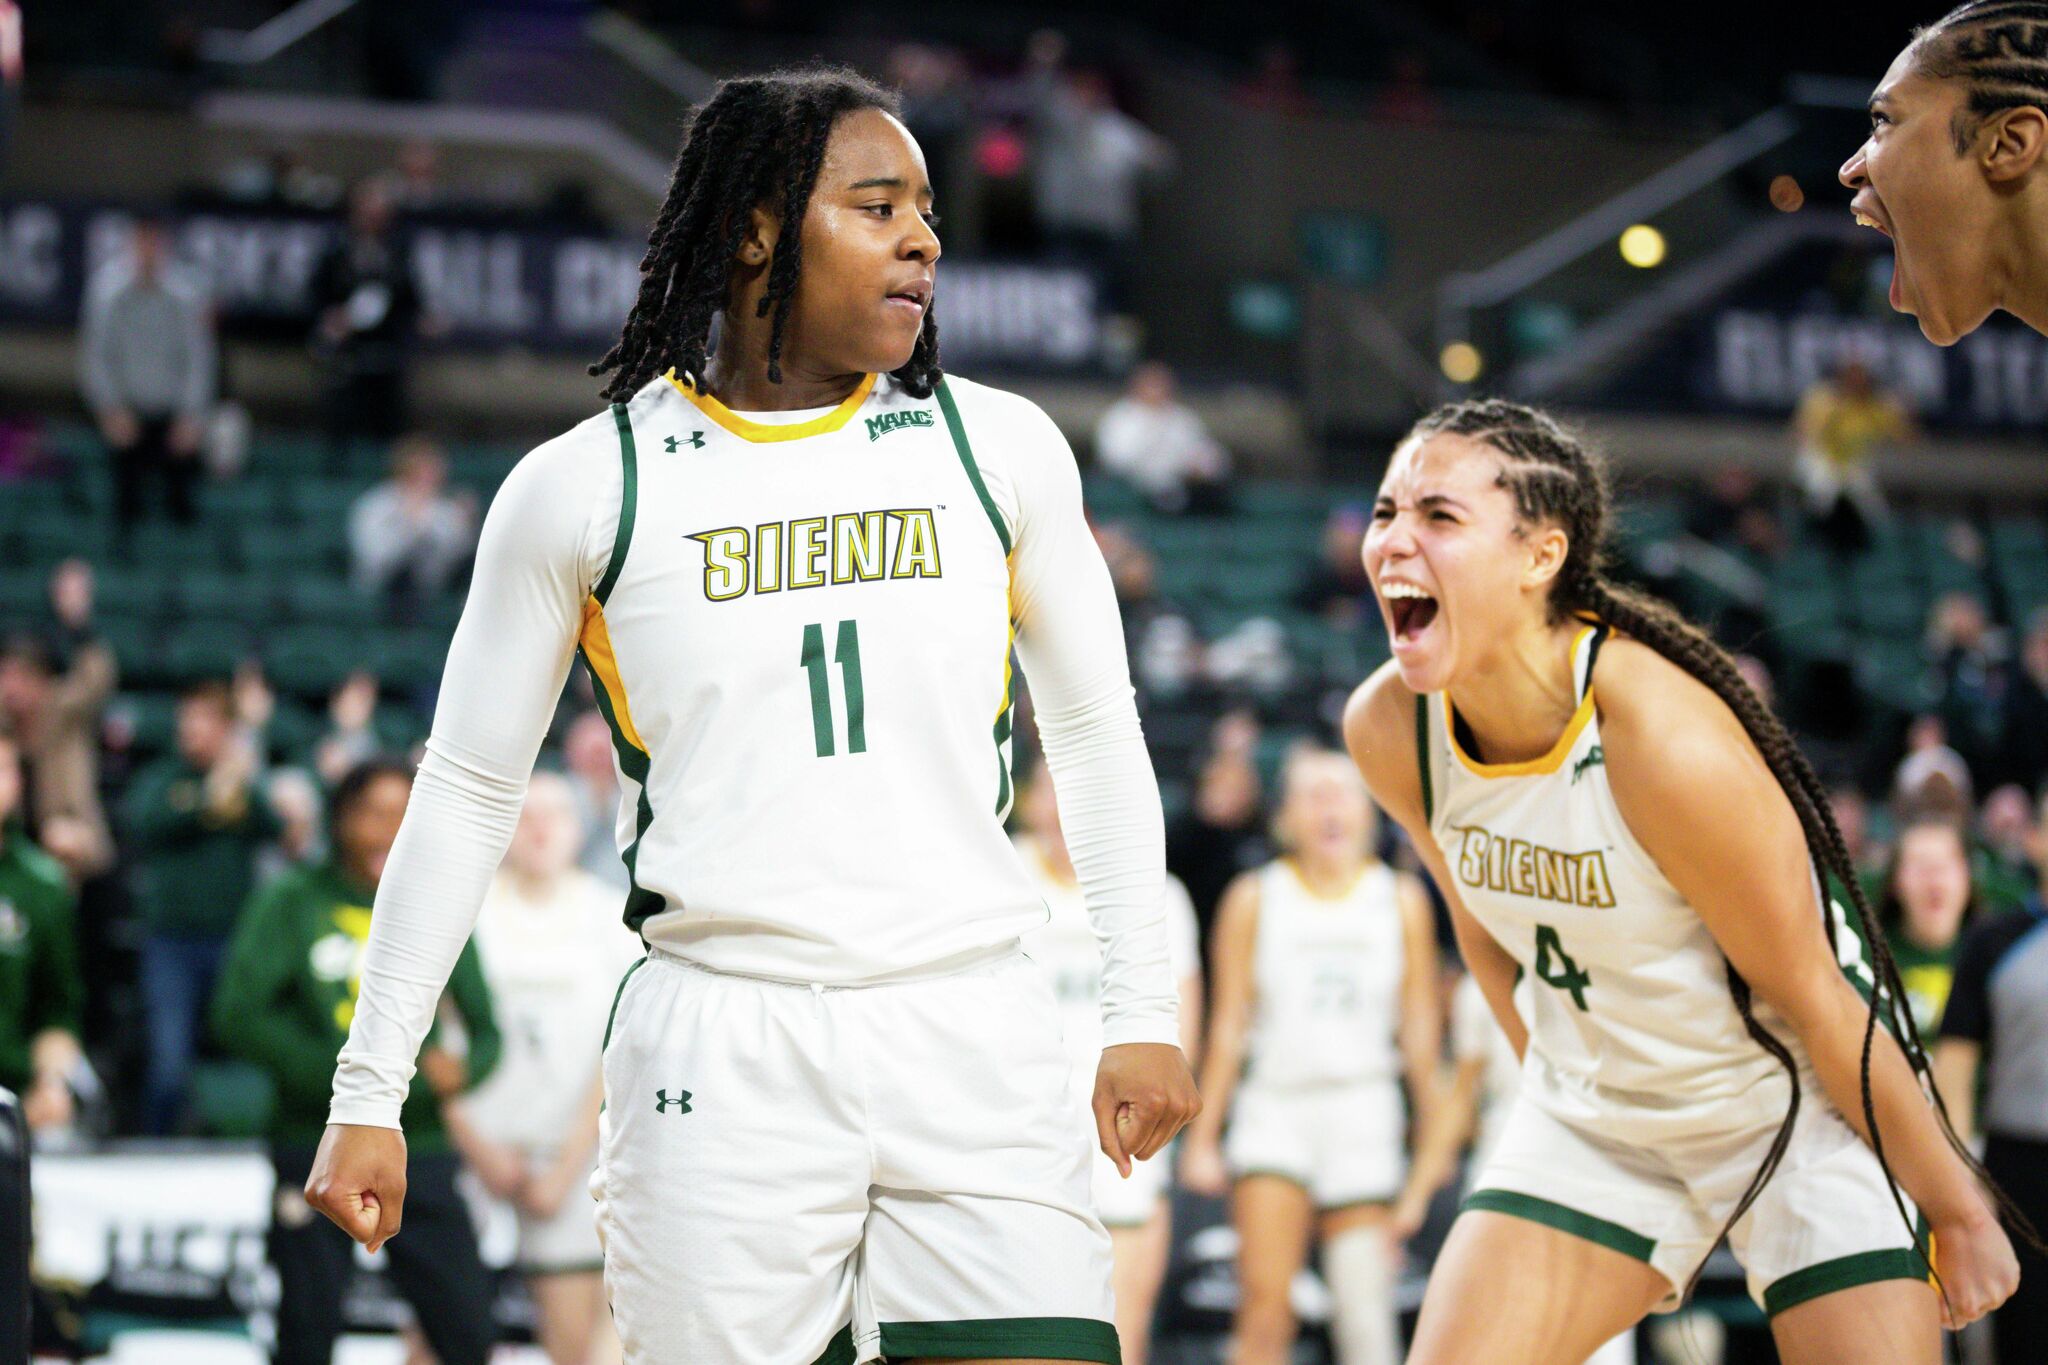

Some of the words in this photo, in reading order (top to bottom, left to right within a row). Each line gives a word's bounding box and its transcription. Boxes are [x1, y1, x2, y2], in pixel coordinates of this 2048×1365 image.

[864, 410, 934, 442] MAAC
[682, 508, 942, 602] SIENA
[800, 619, 866, 757] 11
[1451, 825, 1616, 908] SIENA
[1535, 923, 1591, 1012] 4
